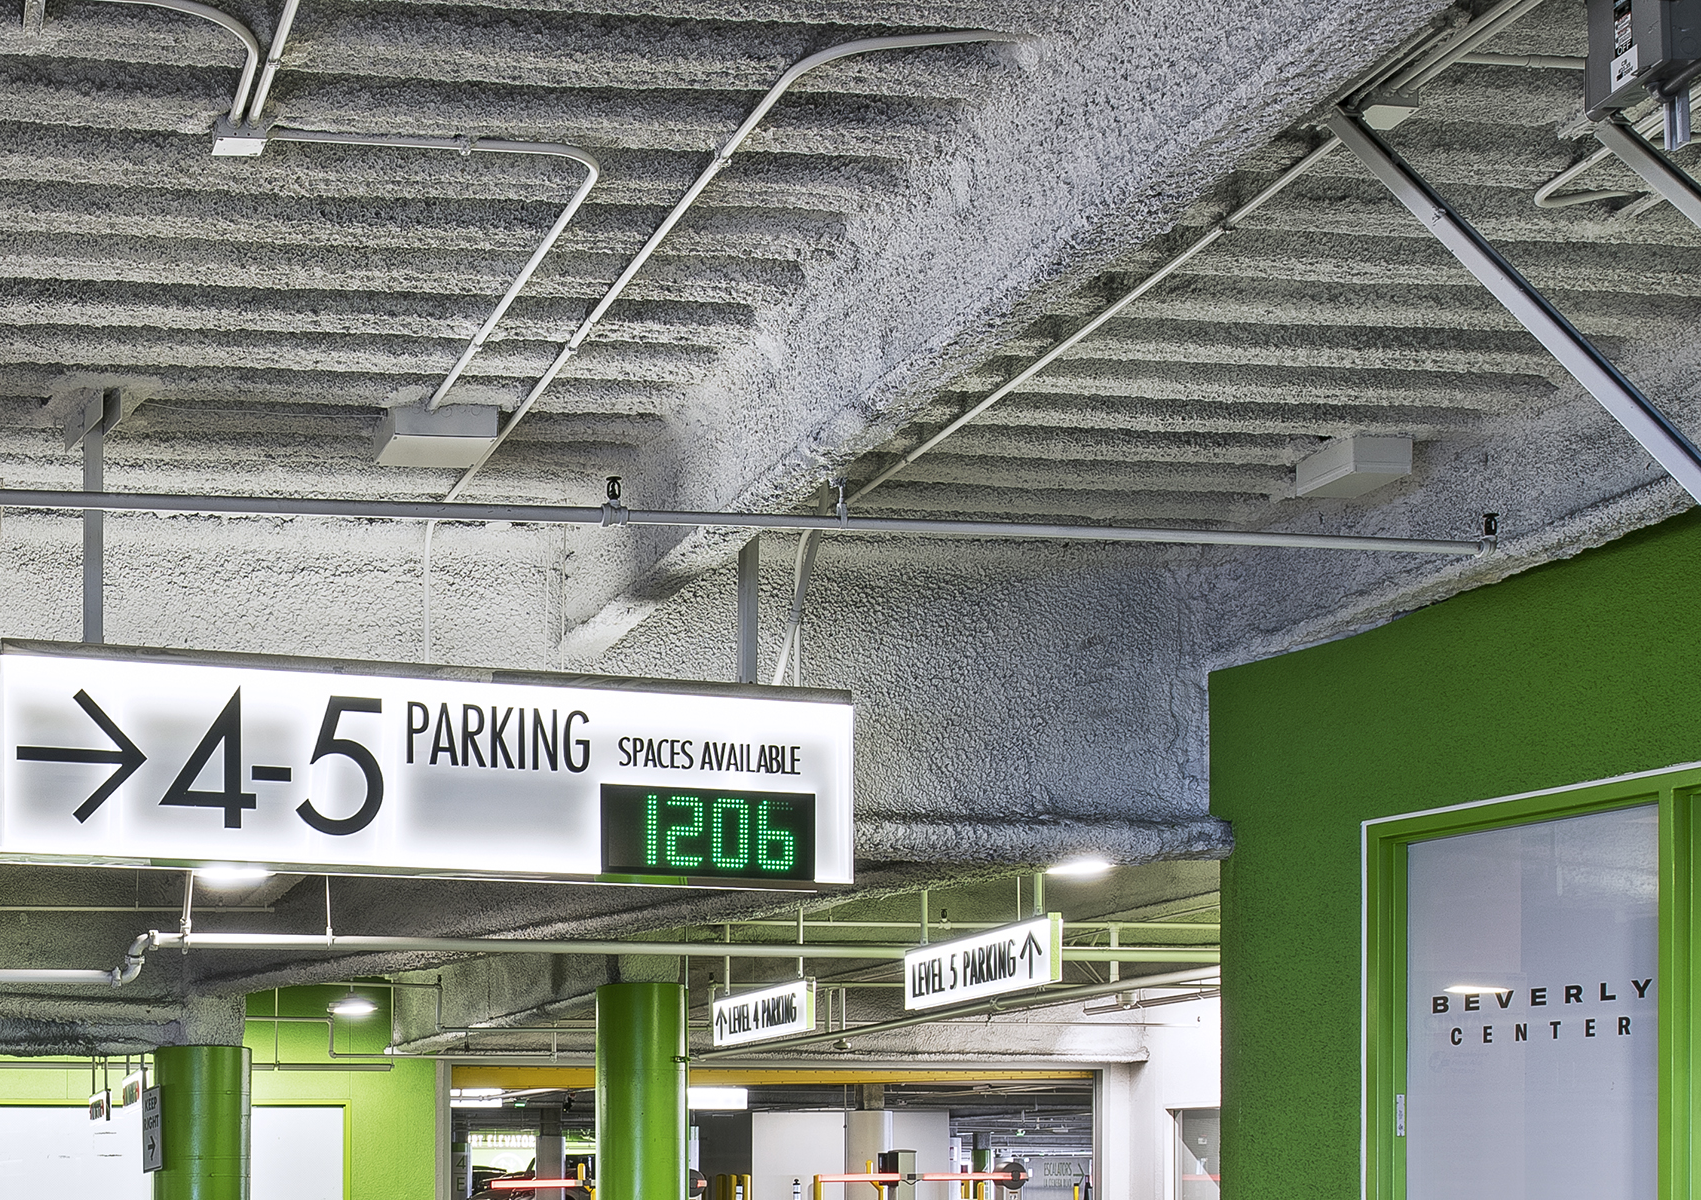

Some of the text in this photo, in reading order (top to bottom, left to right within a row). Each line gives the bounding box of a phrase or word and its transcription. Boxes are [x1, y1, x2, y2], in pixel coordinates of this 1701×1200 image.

[1617, 41, 1631, 55] OFF
[158, 685, 591, 836] 4-5 PARKING
[618, 736, 801, 775] SPACES AVAILABLE
[647, 794, 794, 870] 1206
[912, 938, 1017, 999] LEVEL 5 PARKING
[1431, 978, 1653, 1014] BEVERLY
[728, 996, 797, 1035] LEVEL 4 PARKING
[1450, 1016, 1631, 1046] CENTER
[145, 1096, 158, 1113] KEEP
[144, 1114, 159, 1131] RIGHT
[456, 1155, 466, 1170] 4
[1044, 1162, 1073, 1177] ESCALATORS
[456, 1177, 465, 1192] E
